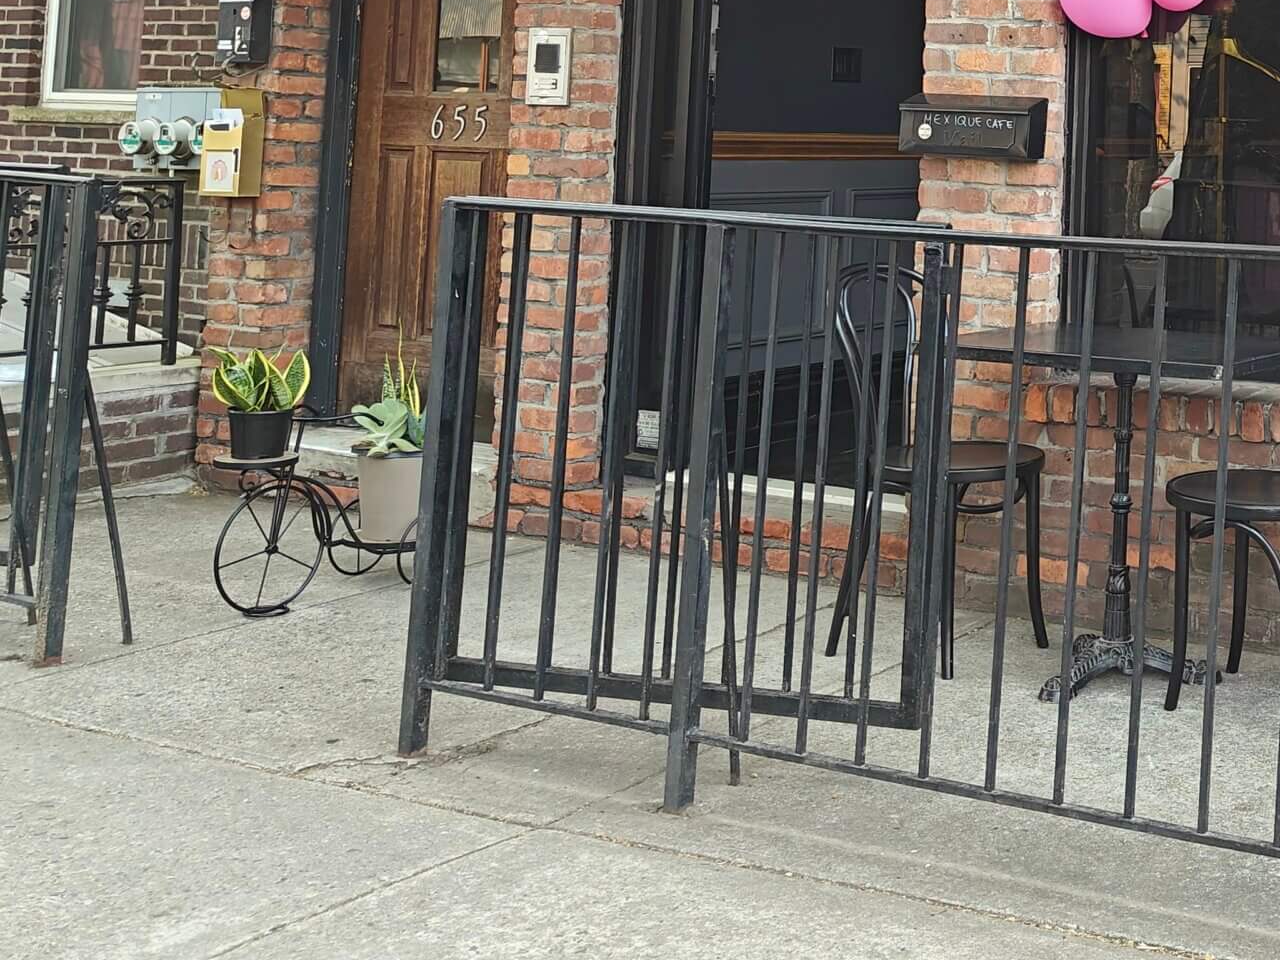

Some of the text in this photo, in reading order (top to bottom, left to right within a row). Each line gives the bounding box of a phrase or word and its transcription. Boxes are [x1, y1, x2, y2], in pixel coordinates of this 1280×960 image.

[431, 104, 489, 141] 655
[923, 113, 1014, 130] MEXIQUE CAFE
